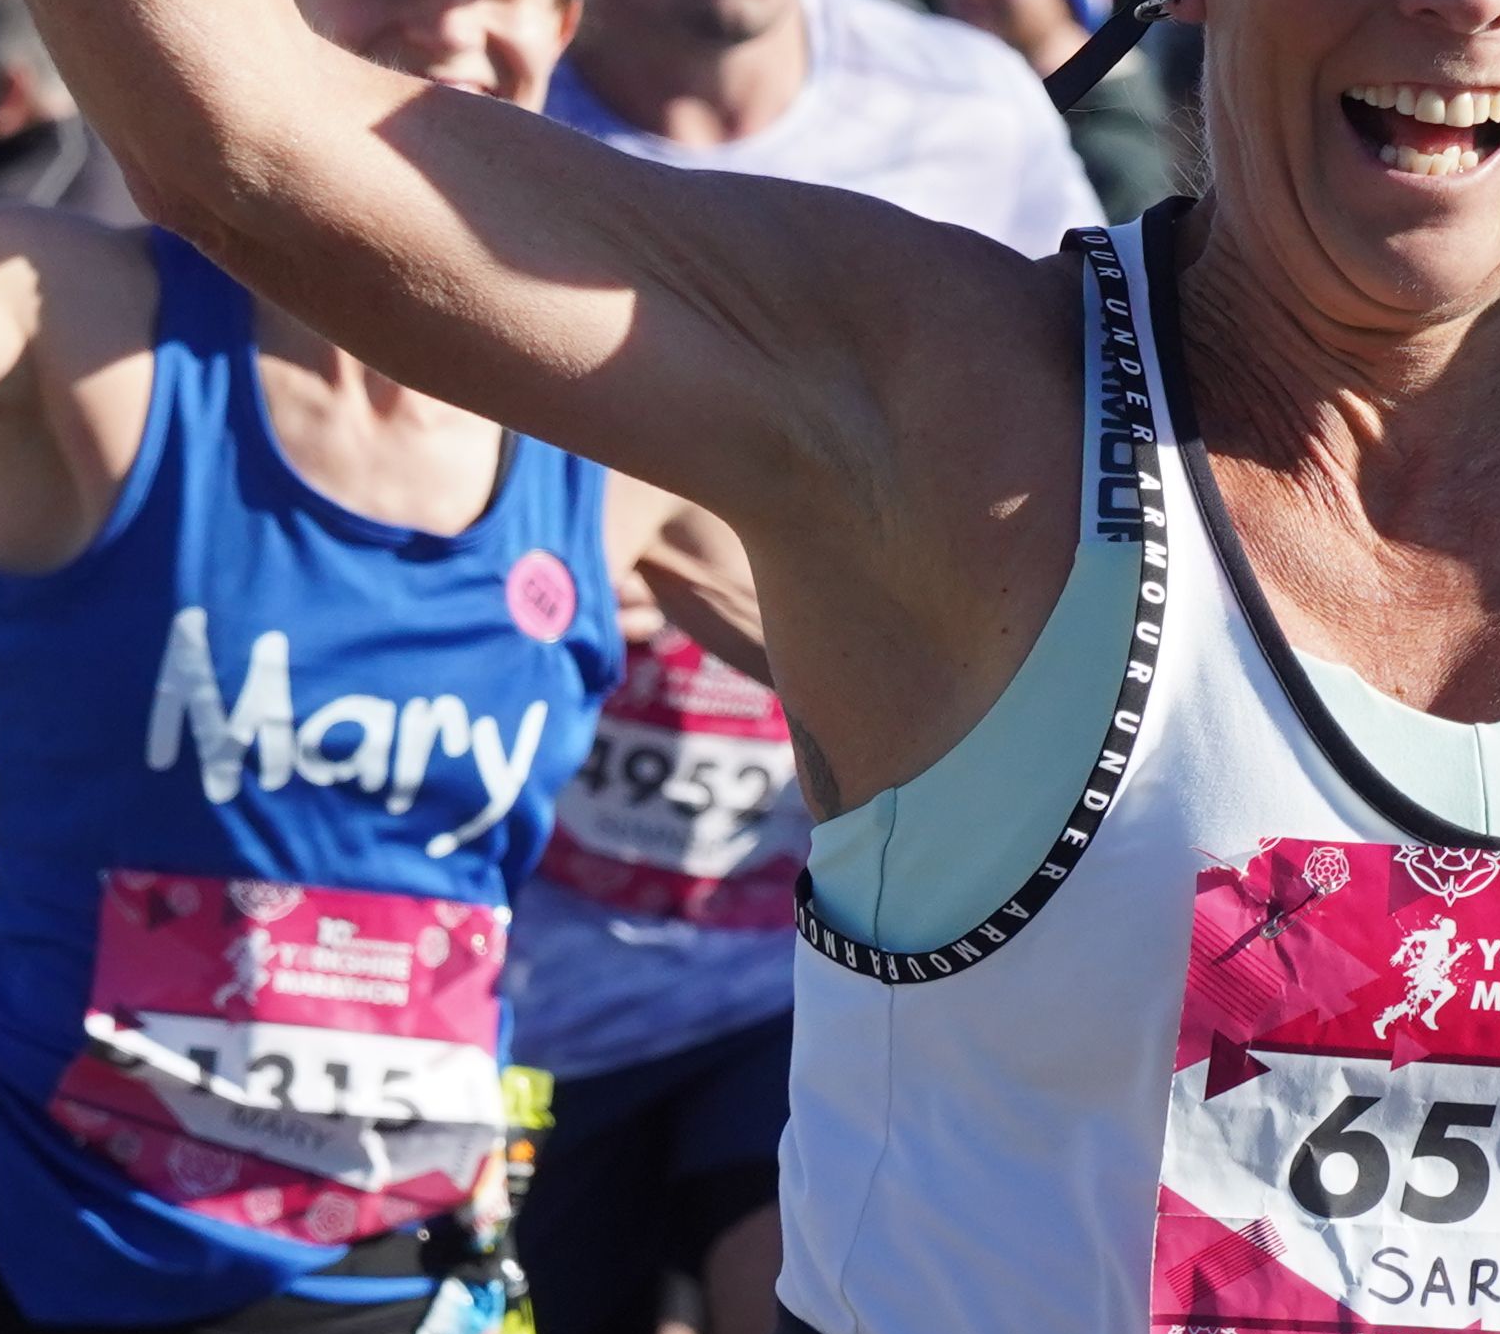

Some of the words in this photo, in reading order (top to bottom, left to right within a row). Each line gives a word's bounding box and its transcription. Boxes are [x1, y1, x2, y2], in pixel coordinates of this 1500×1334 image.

[1106, 298, 1155, 443] UNDER
[1126, 471, 1168, 684] ARMOUR
[146, 606, 548, 858] Mary
[1039, 710, 1141, 880] UNDER
[794, 898, 883, 976] ARMOU
[886, 901, 1030, 981] ARMOUR
